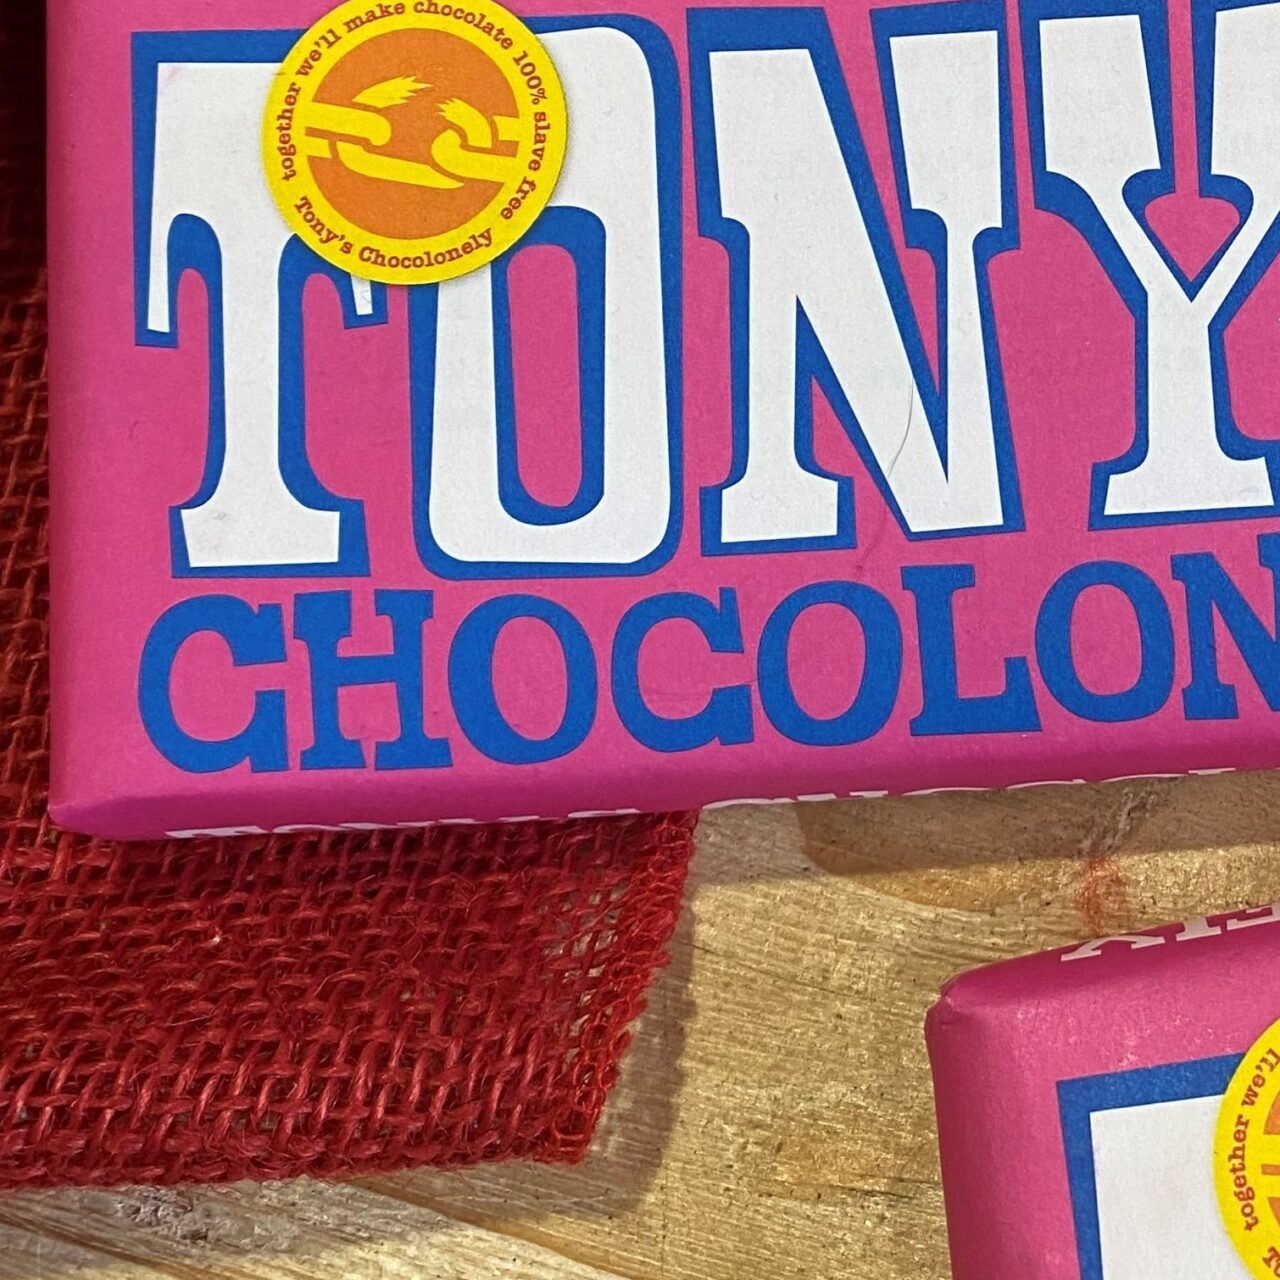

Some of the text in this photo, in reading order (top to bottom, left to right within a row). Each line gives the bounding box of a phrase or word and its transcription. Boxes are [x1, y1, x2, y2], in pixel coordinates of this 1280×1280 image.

[342, 0, 406, 33] make
[296, 28, 343, 78] we'll
[512, 49, 549, 106] 100%
[276, 81, 303, 182] together
[527, 110, 551, 173] slave
[500, 175, 537, 221] free
[294, 195, 494, 270] Tony's Chocolonely
[1228, 1113, 1260, 1232] together
